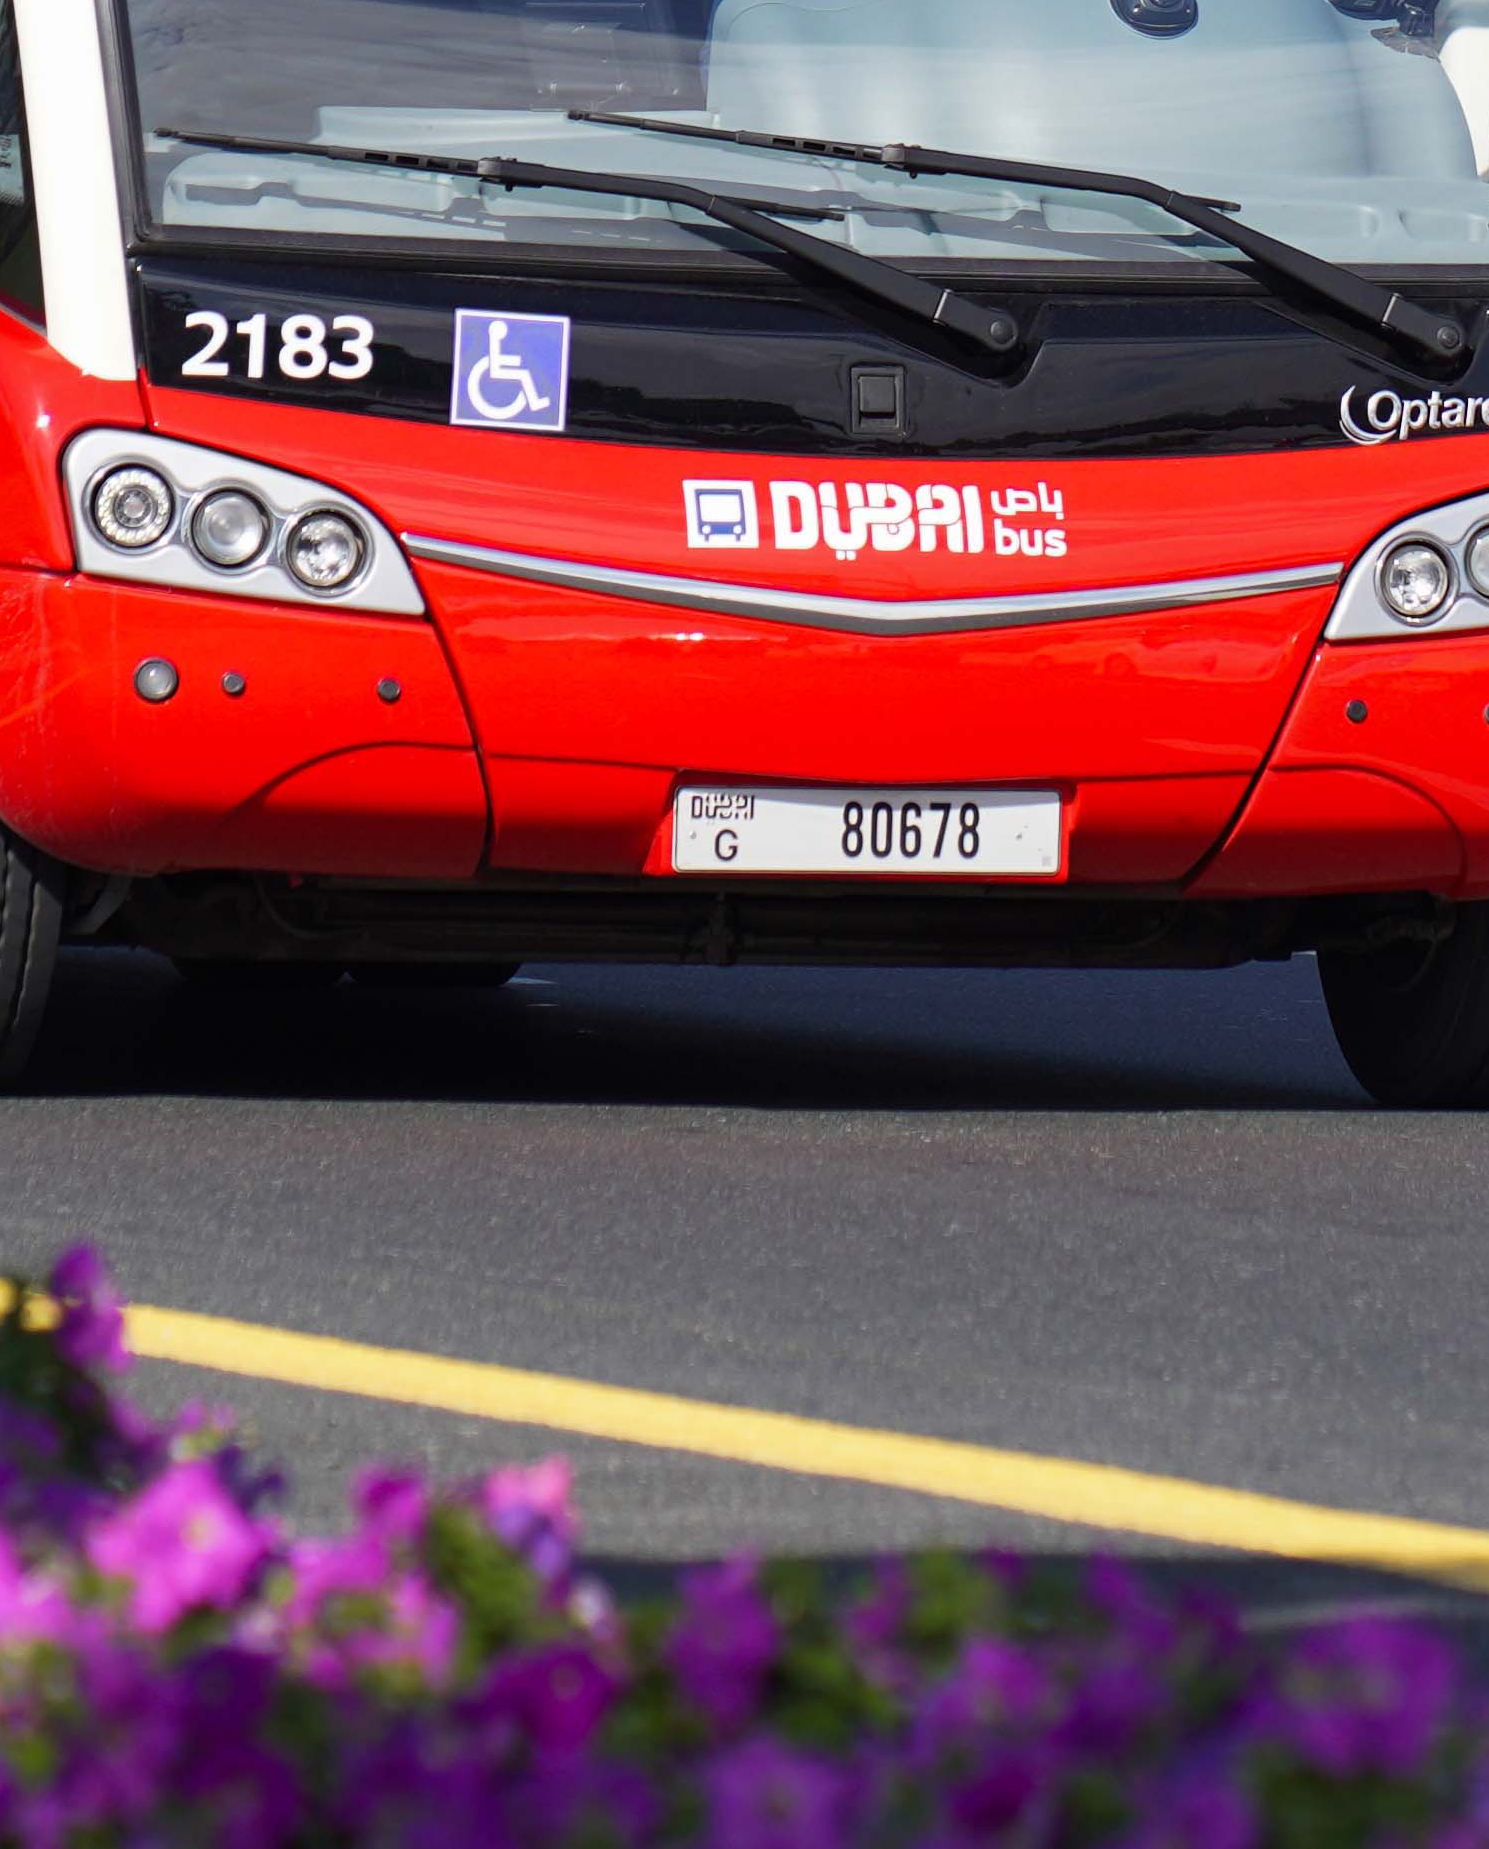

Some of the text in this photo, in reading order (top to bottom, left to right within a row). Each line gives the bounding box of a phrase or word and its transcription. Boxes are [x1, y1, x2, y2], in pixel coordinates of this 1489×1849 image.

[181, 311, 374, 380] 2183
[769, 480, 984, 561] DUBAI
[993, 518, 1067, 557] bus
[714, 828, 738, 862] G
[841, 801, 981, 860] 80678
